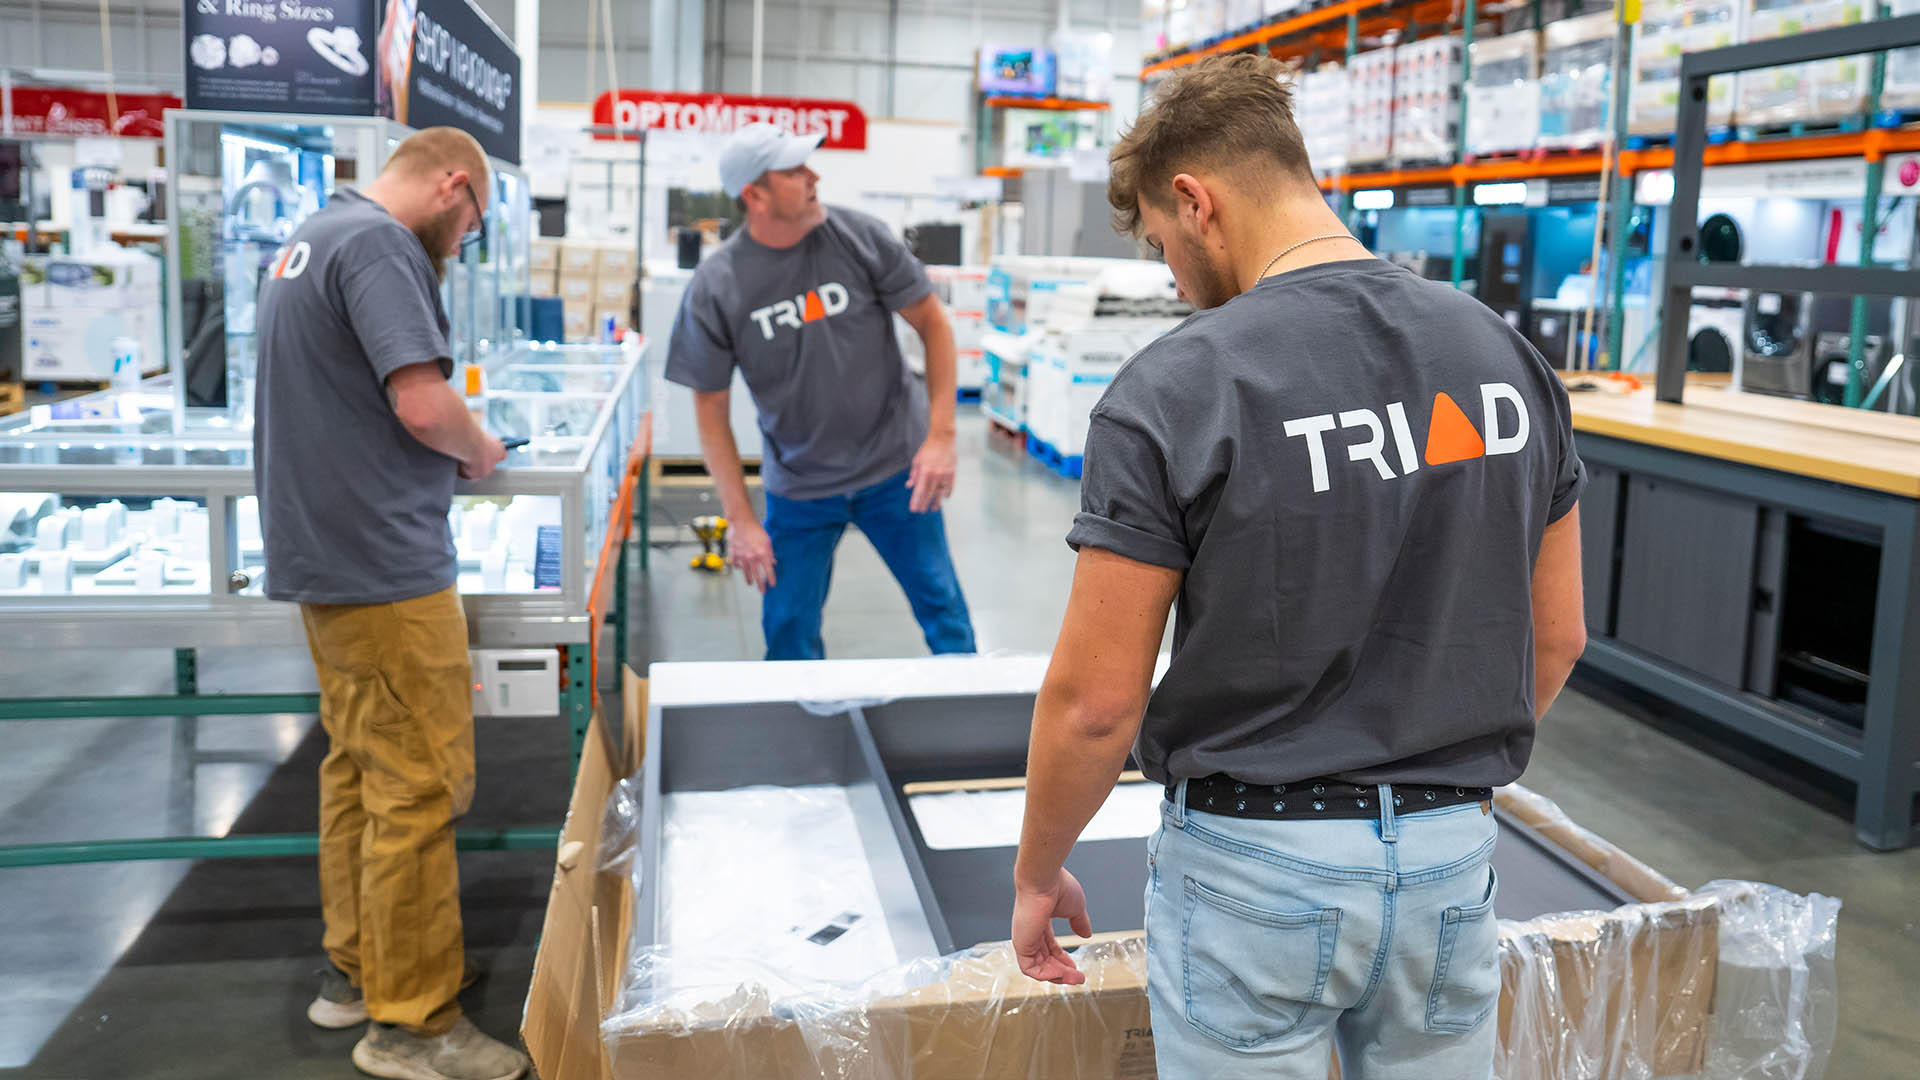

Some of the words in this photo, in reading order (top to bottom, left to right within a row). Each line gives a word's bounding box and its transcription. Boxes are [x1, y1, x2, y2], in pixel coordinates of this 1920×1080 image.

[225, 0, 277, 22] Ring
[279, 1, 334, 21] Sizes
[614, 101, 849, 140] OPTOMETRIST
[750, 282, 849, 340] TRIAD
[1283, 382, 1530, 493] TRIAD
